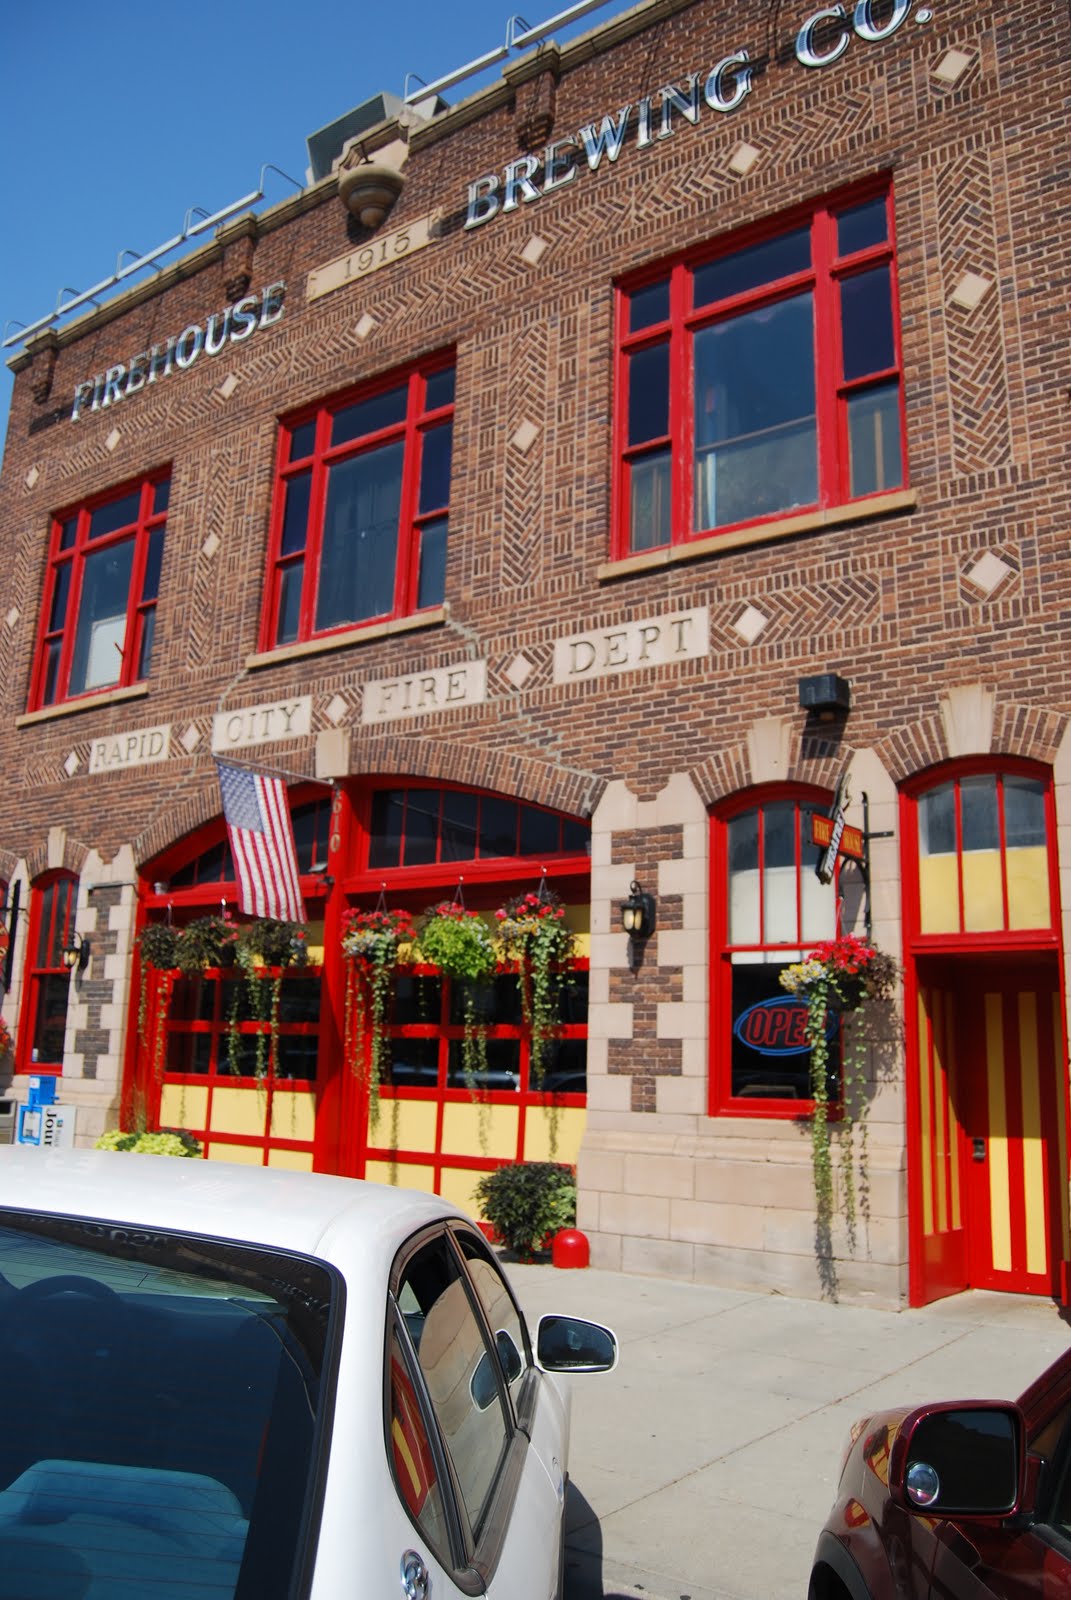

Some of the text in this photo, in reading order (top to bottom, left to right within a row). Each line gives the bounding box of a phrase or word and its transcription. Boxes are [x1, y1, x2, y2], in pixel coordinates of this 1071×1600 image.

[71, 0, 934, 424] FIREHOUSE BREWING CO.
[344, 229, 410, 279] 1915
[93, 617, 693, 770] RAPID CITY FIRE DEPT
[745, 1007, 829, 1047] OPE
